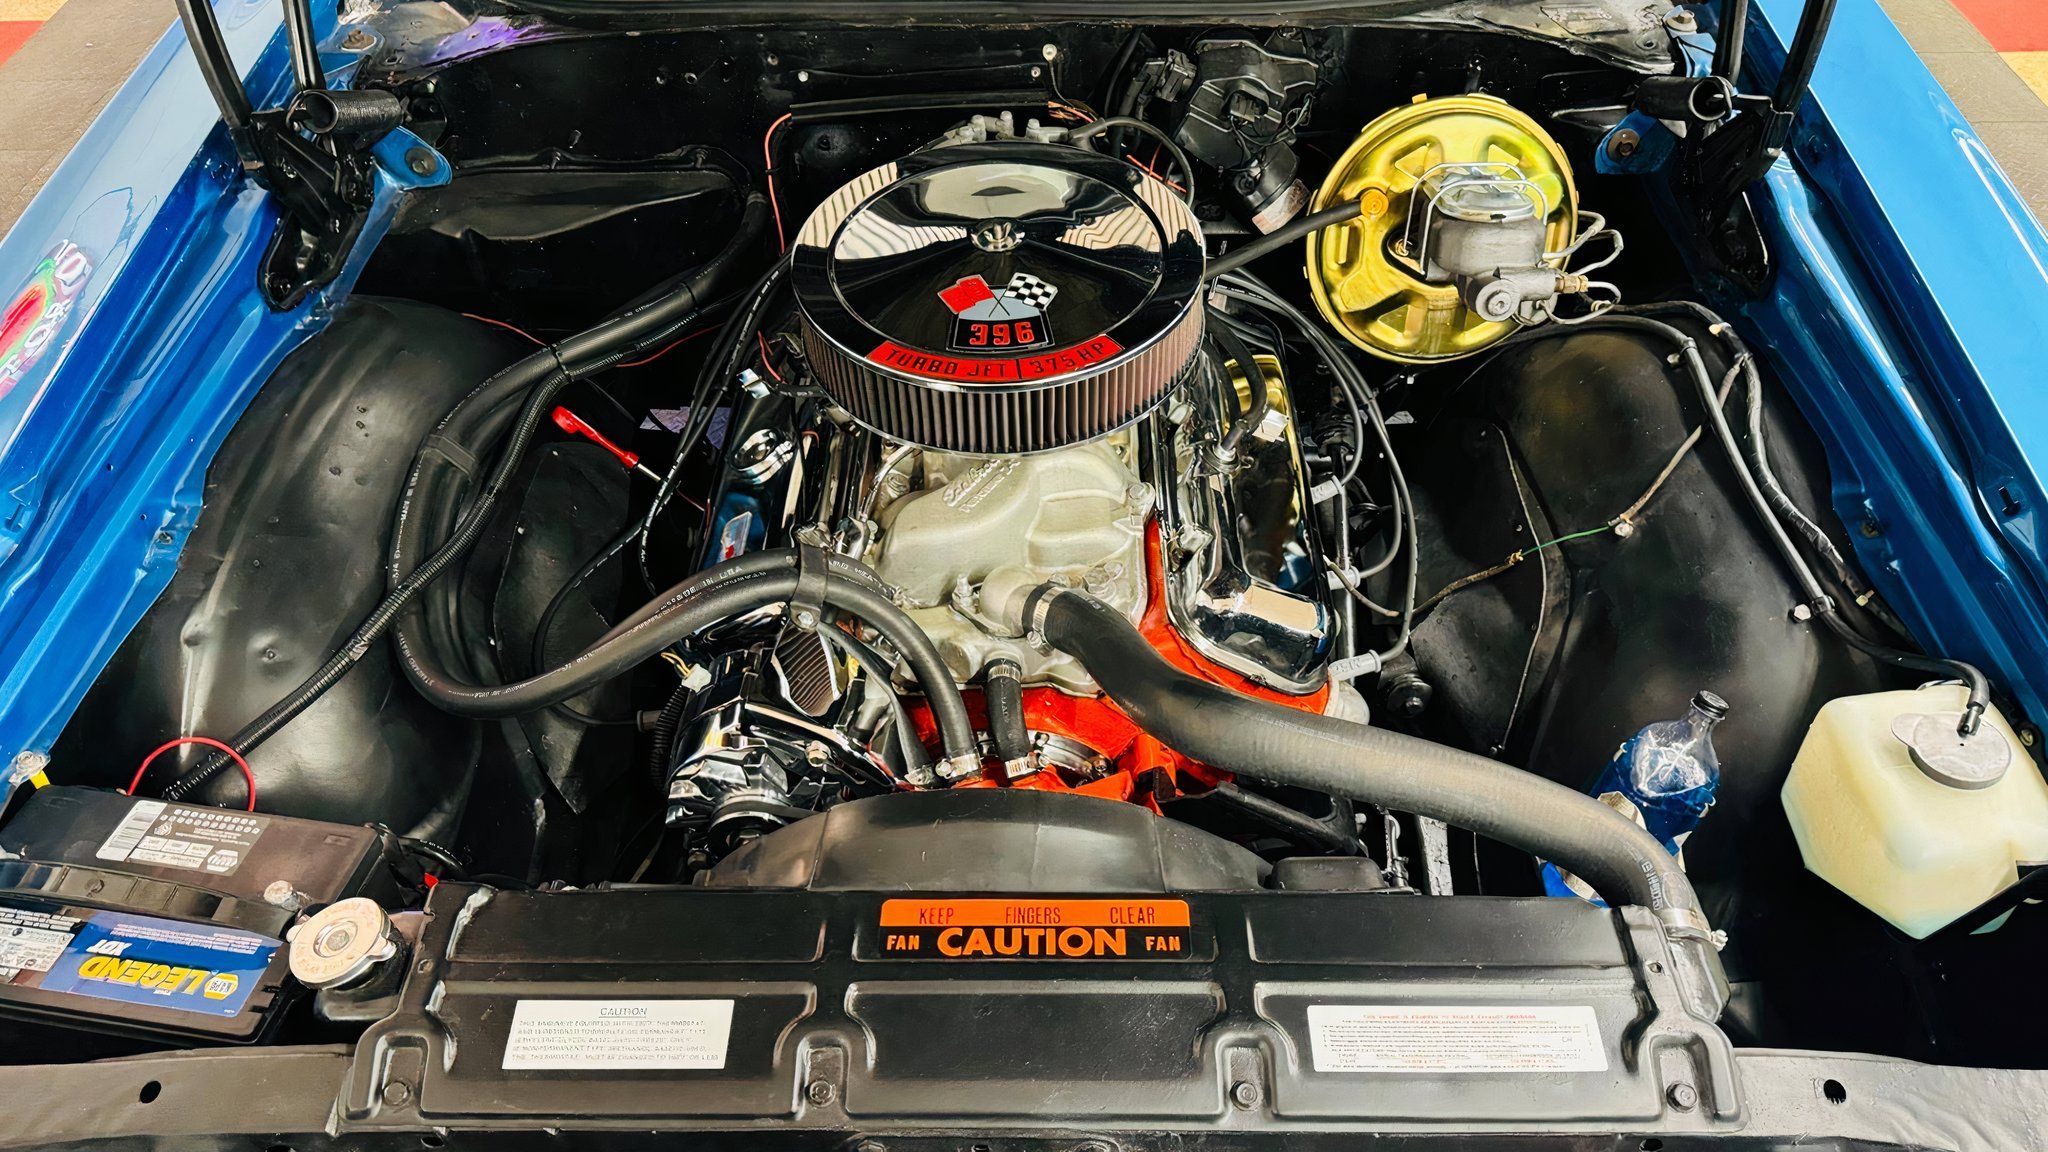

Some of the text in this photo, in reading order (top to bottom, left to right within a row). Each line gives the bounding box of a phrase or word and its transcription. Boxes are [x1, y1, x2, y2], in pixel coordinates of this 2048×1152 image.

[969, 321, 1035, 345] 396
[884, 348, 959, 375] TURBO
[1029, 354, 1075, 373] 375
[1079, 342, 1105, 361] HP
[919, 906, 1156, 925] KEEP FINGERS CLEAR
[86, 939, 132, 956] XDT
[886, 927, 1181, 957] FAN CAUTION FAN
[78, 956, 212, 996] LEGEND
[600, 1007, 648, 1016] CAUTION
